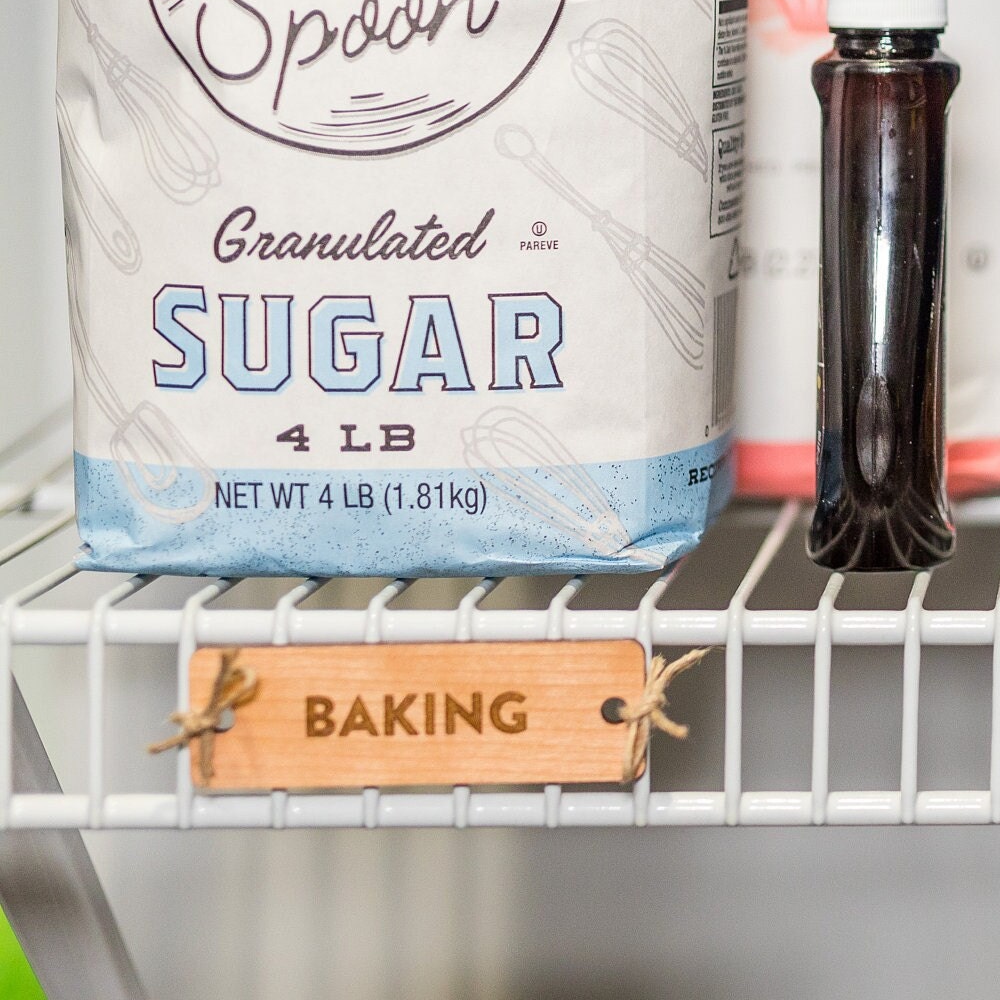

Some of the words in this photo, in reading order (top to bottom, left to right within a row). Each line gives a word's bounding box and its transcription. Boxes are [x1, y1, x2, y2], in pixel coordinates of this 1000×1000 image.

[213, 205, 496, 264] Granulated
[520, 240, 559, 251] PAREVE
[152, 283, 565, 393] SUGAR
[276, 424, 311, 452] 4
[340, 424, 416, 453] LB
[214, 482, 262, 510] NET
[271, 482, 310, 510] WT
[319, 481, 334, 510] 4
[343, 481, 374, 510] LB
[384, 481, 488, 515] (1.81kg)
[306, 691, 528, 738] BAKING
